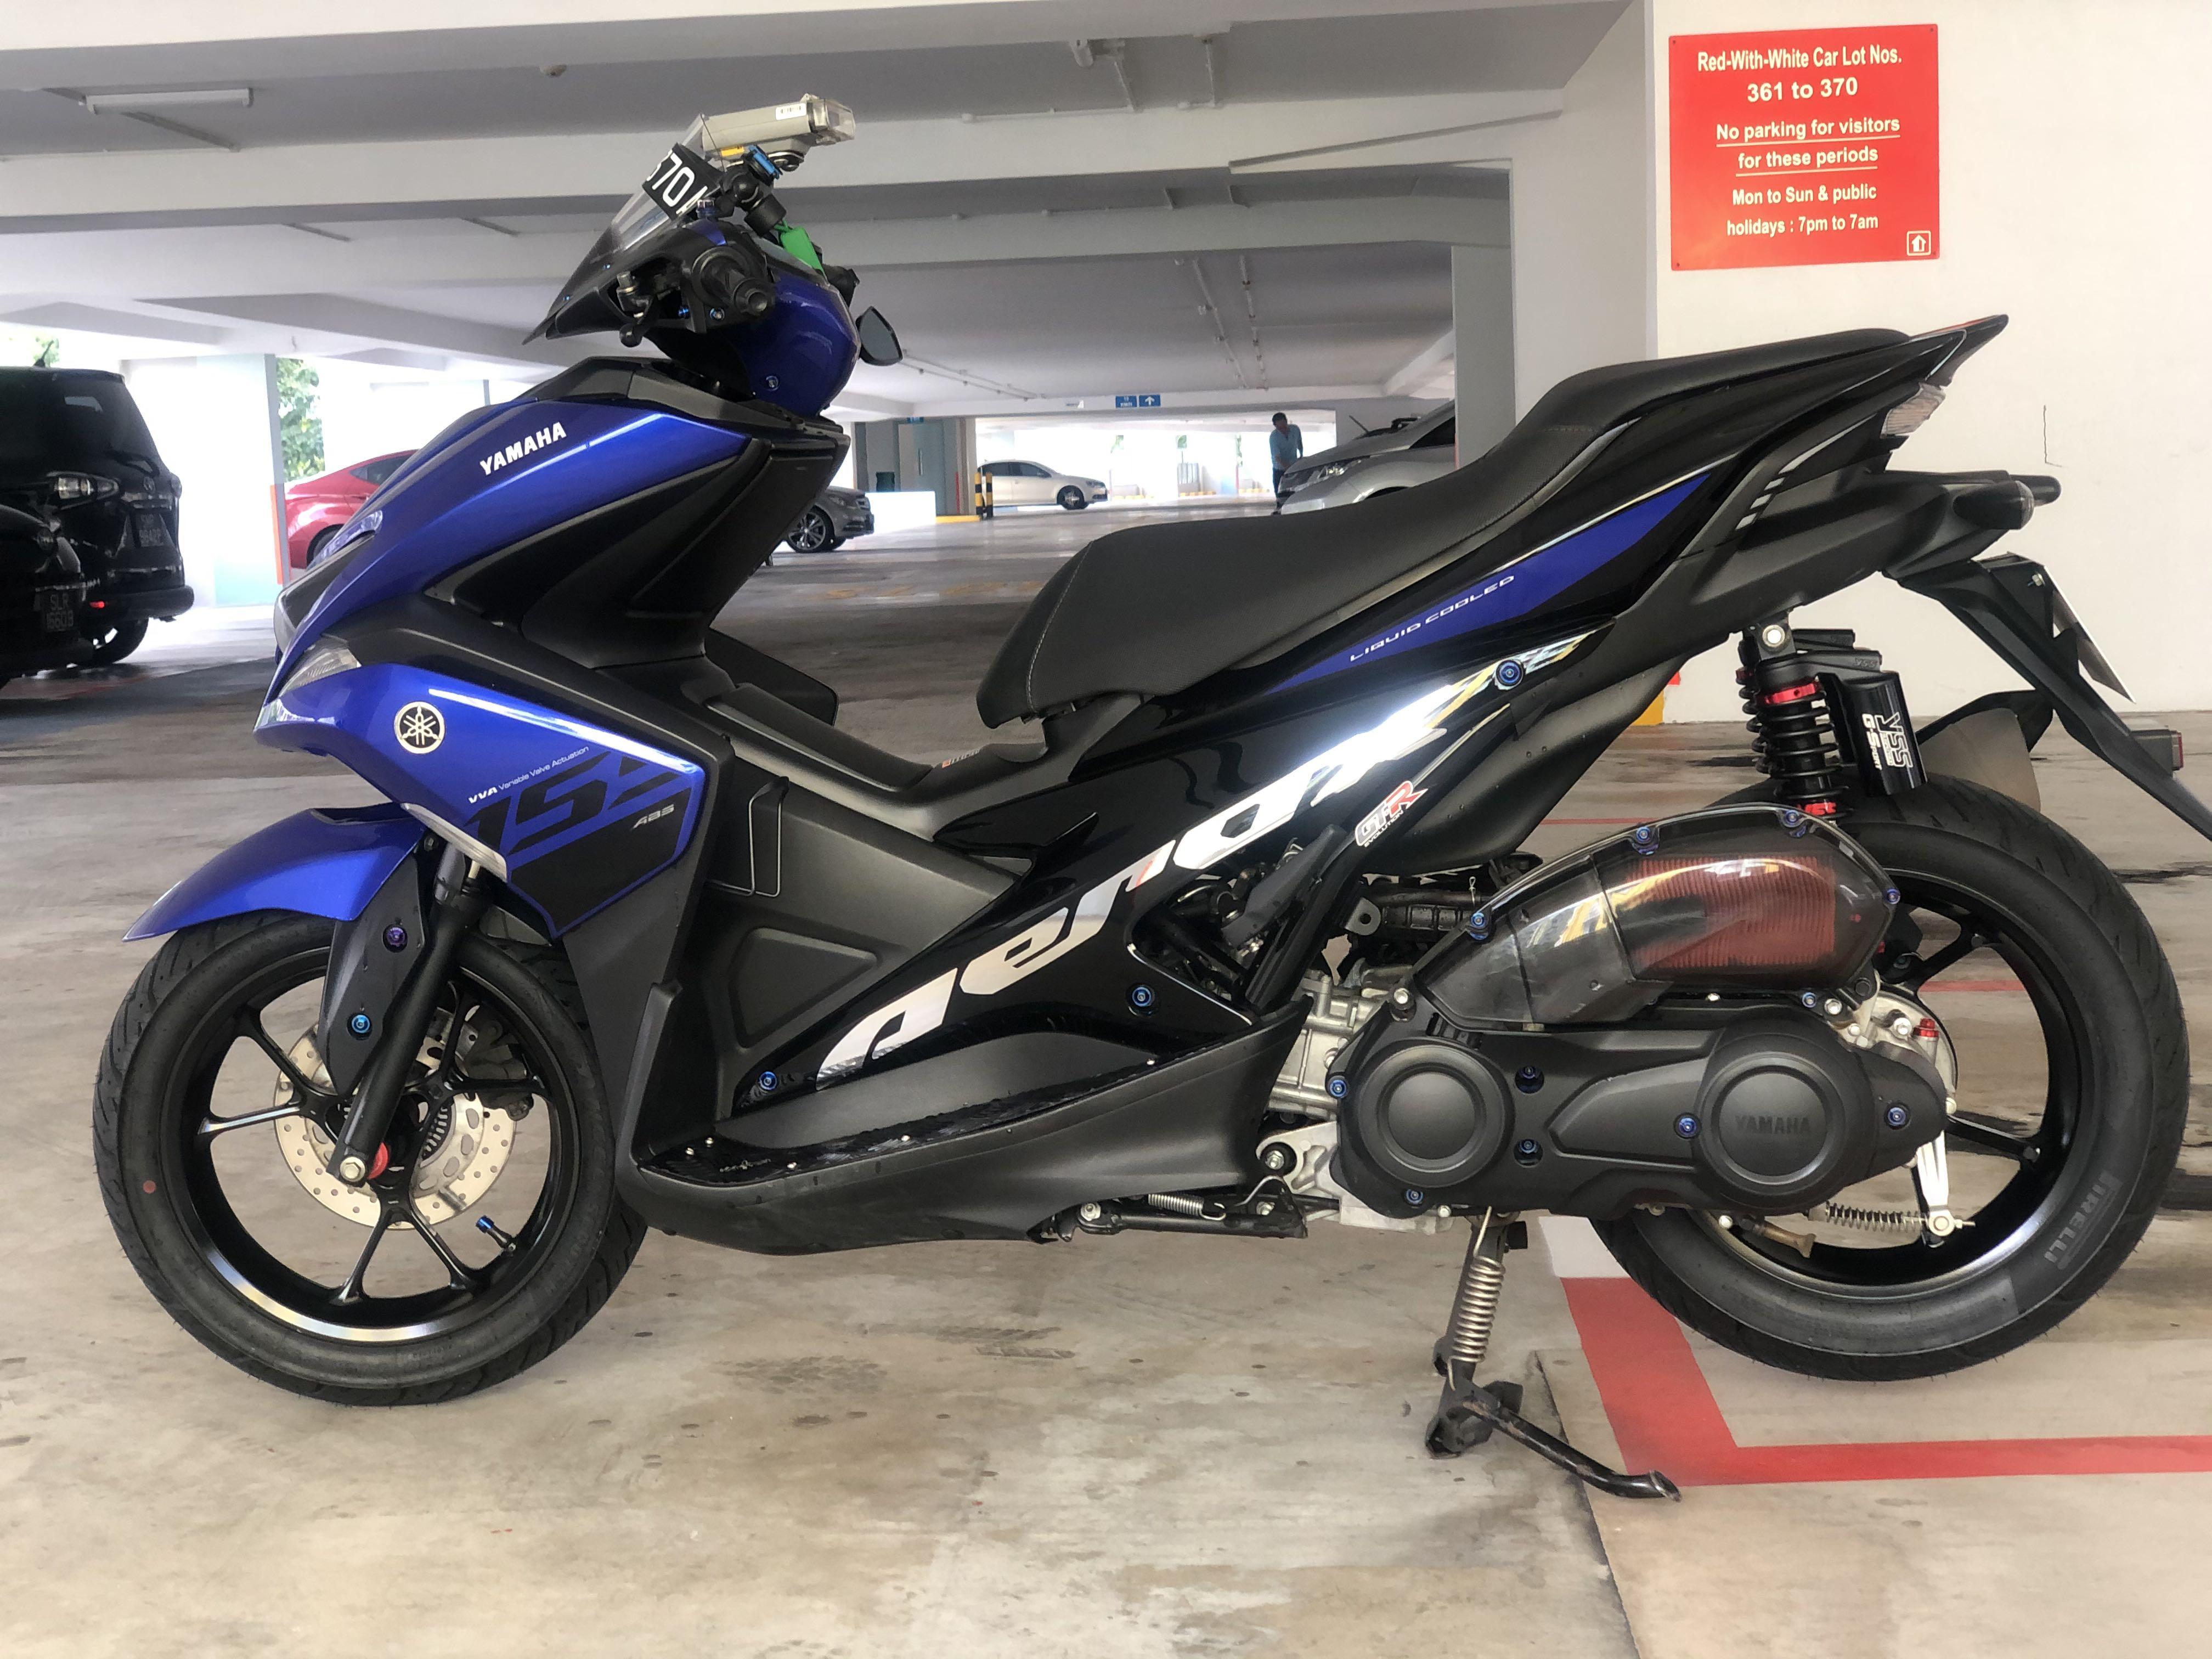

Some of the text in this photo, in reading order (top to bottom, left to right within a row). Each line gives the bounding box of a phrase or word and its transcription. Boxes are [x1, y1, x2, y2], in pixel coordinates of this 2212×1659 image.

[1697, 44, 1903, 71] Red-With-White Car Lot Nos.
[1747, 77, 1858, 103] 361 to 370
[1716, 117, 1900, 142] No parking for visitors
[1737, 145, 1878, 169] for these periods
[1732, 183, 1877, 206] Mon to Sun & public
[1726, 218, 1786, 238] holidays
[1798, 216, 1828, 235] 7pm
[1831, 215, 1846, 230] to
[1849, 213, 1878, 229] 7am
[479, 421, 567, 476] YAMAHA
[1350, 575, 1515, 662] LIQUID COOLED
[1874, 712, 1914, 768] YSS
[468, 746, 590, 804] VVA Variable Valve Actuation
[630, 804, 675, 831] ABS
[1364, 809, 1404, 848] EVOLUTION
[1735, 1114, 1810, 1135] YAMAHA
[2044, 1170, 2124, 1269] PIRELLI
